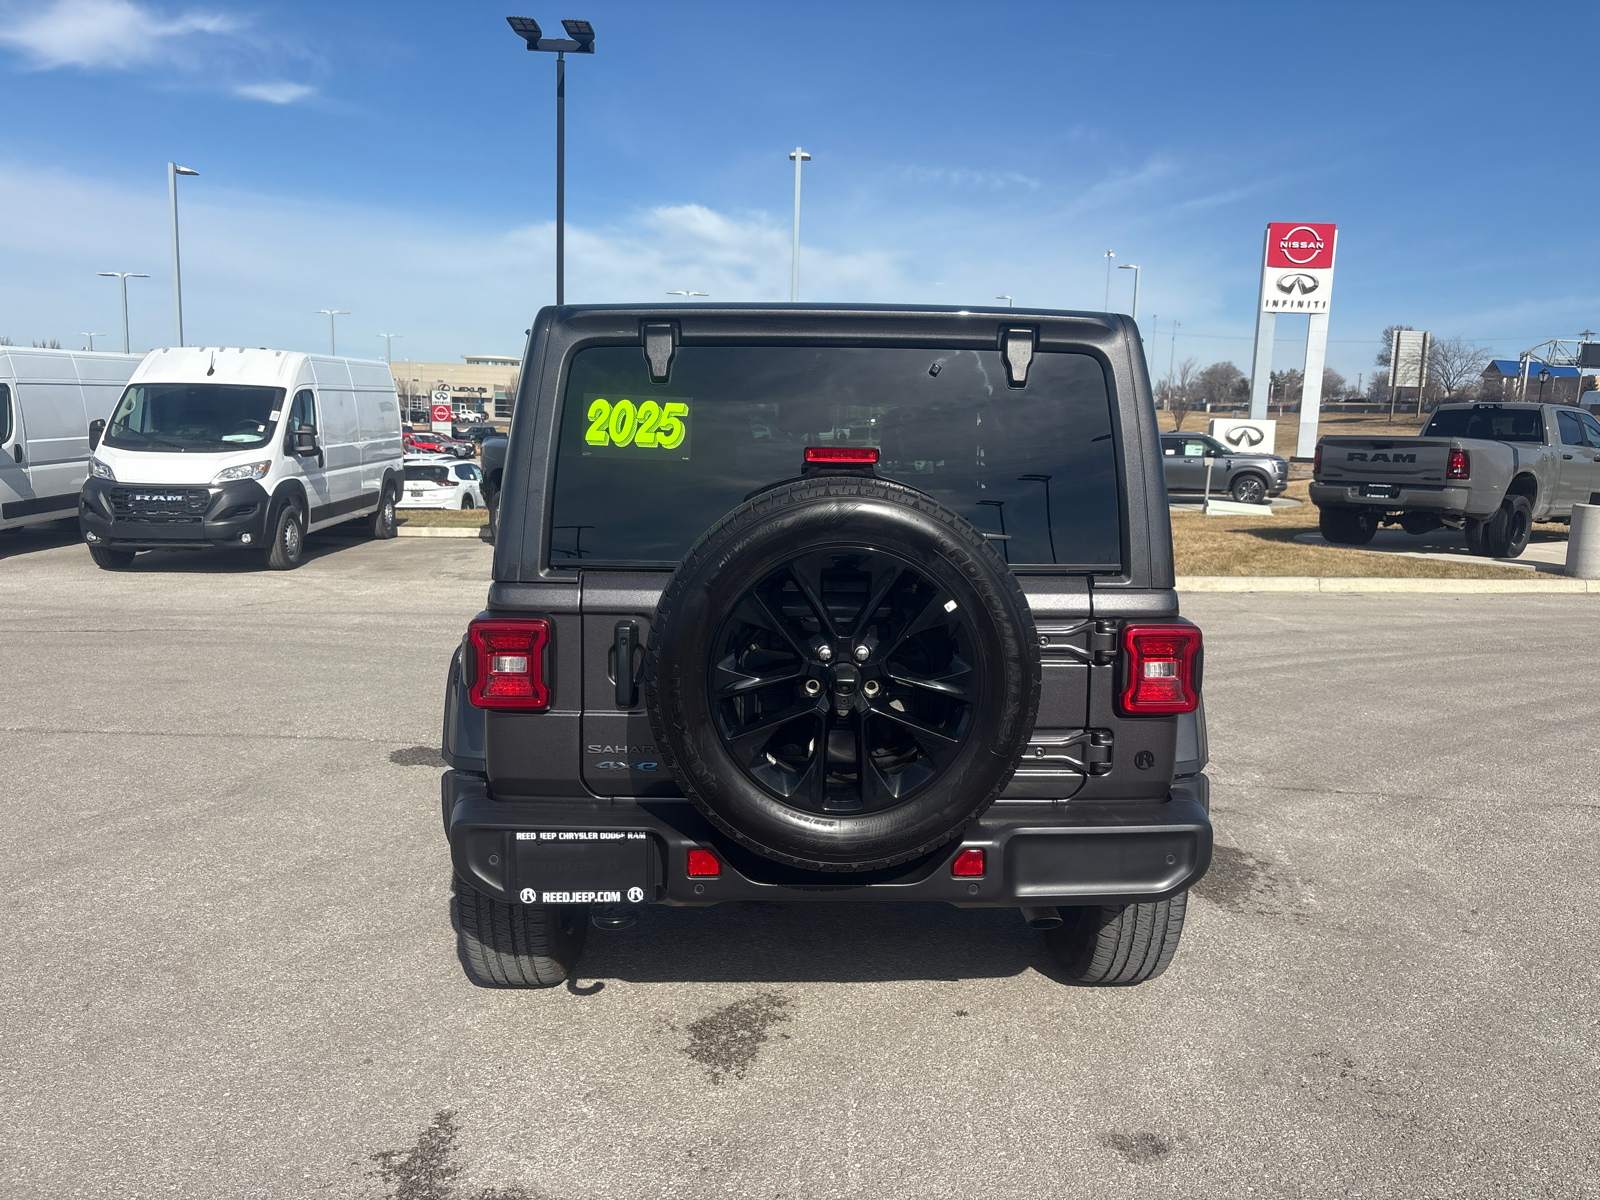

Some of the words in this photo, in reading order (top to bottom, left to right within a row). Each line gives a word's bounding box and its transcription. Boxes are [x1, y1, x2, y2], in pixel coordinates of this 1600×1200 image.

[1280, 241, 1324, 249] NISSAN
[1265, 299, 1326, 309] INFINITI
[585, 398, 689, 449] 2025
[1347, 452, 1417, 463] RAM
[716, 519, 782, 569] All-Weather
[949, 547, 1017, 655] ROADIAN
[666, 677, 715, 783] NEXEN
[516, 832, 536, 840] REED
[559, 832, 598, 840] CHRYSLER
[627, 831, 646, 839] RAM
[542, 891, 621, 903] REEDJEEP.COM
